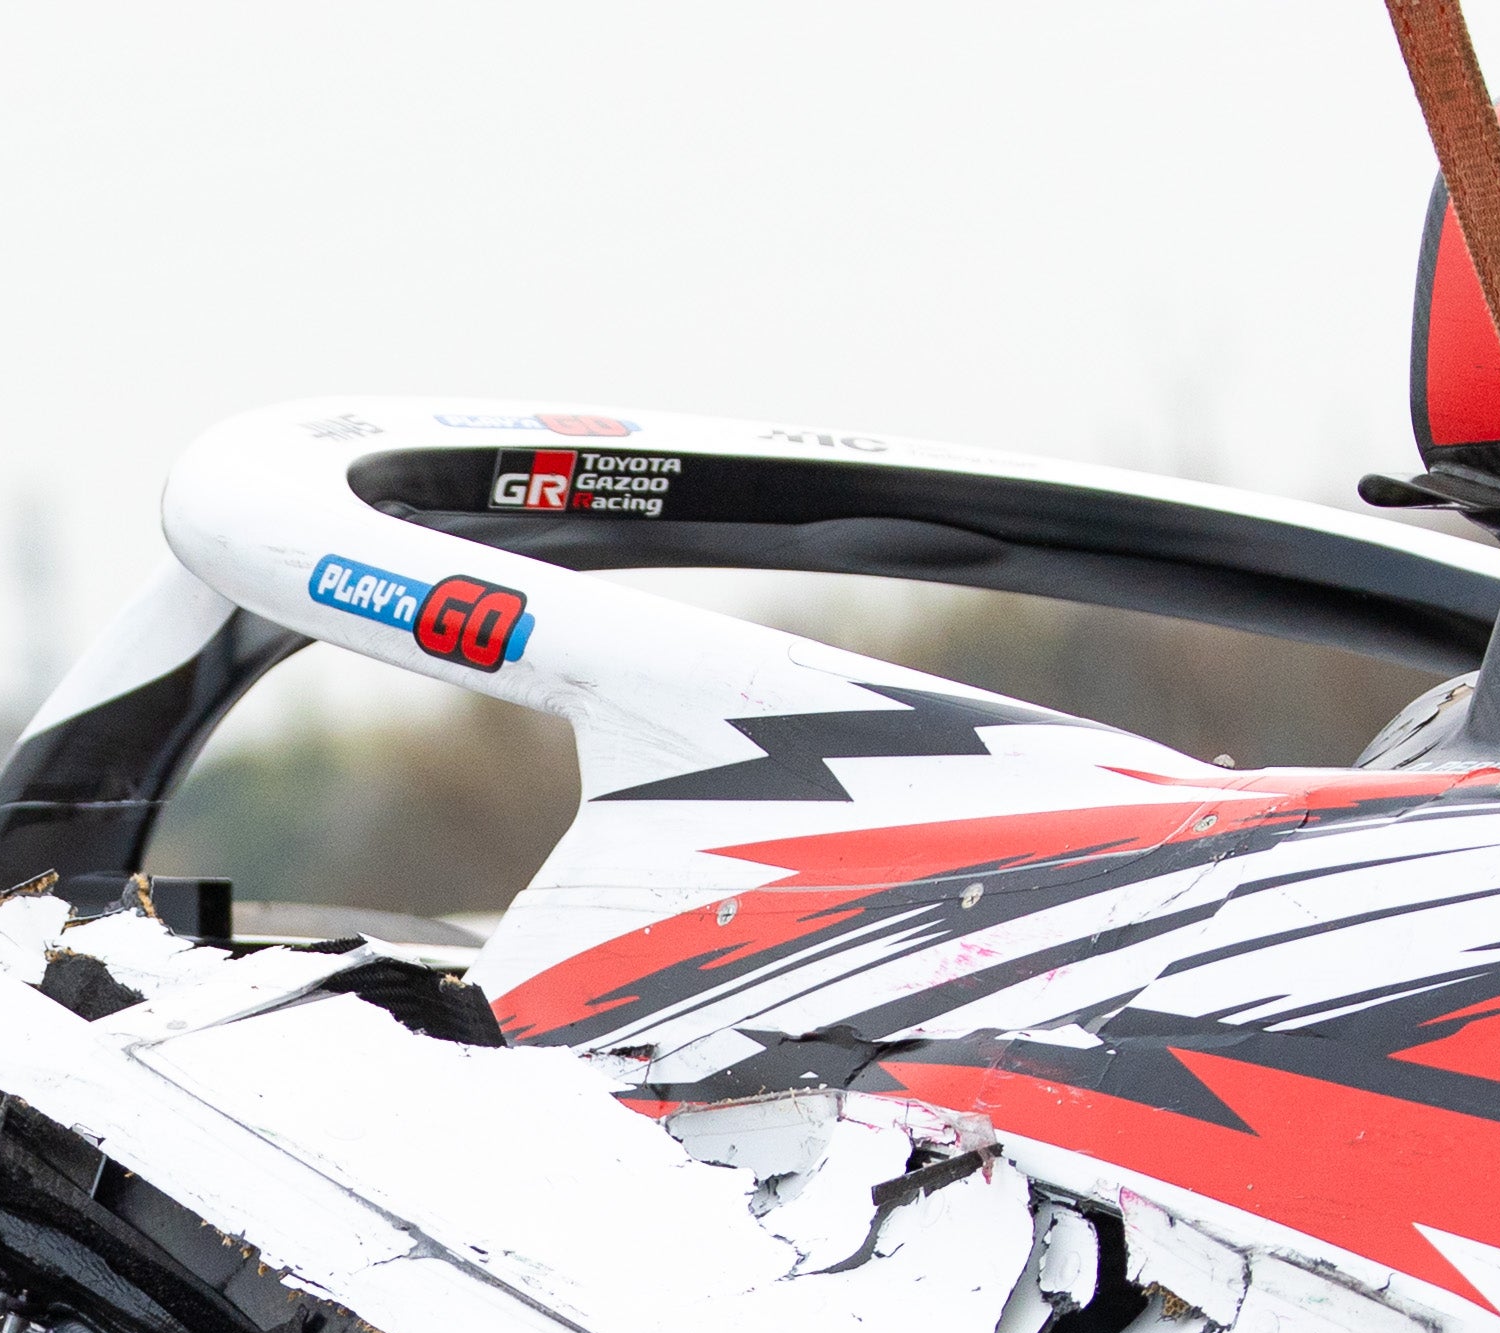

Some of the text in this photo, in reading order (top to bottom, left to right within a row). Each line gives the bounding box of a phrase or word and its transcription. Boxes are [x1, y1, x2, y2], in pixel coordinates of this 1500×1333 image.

[580, 452, 682, 473] TOYOTA
[493, 473, 568, 508] GR
[575, 473, 669, 492] GAZOO
[572, 493, 664, 517] Racing
[317, 563, 522, 667] PLAY'n GO
